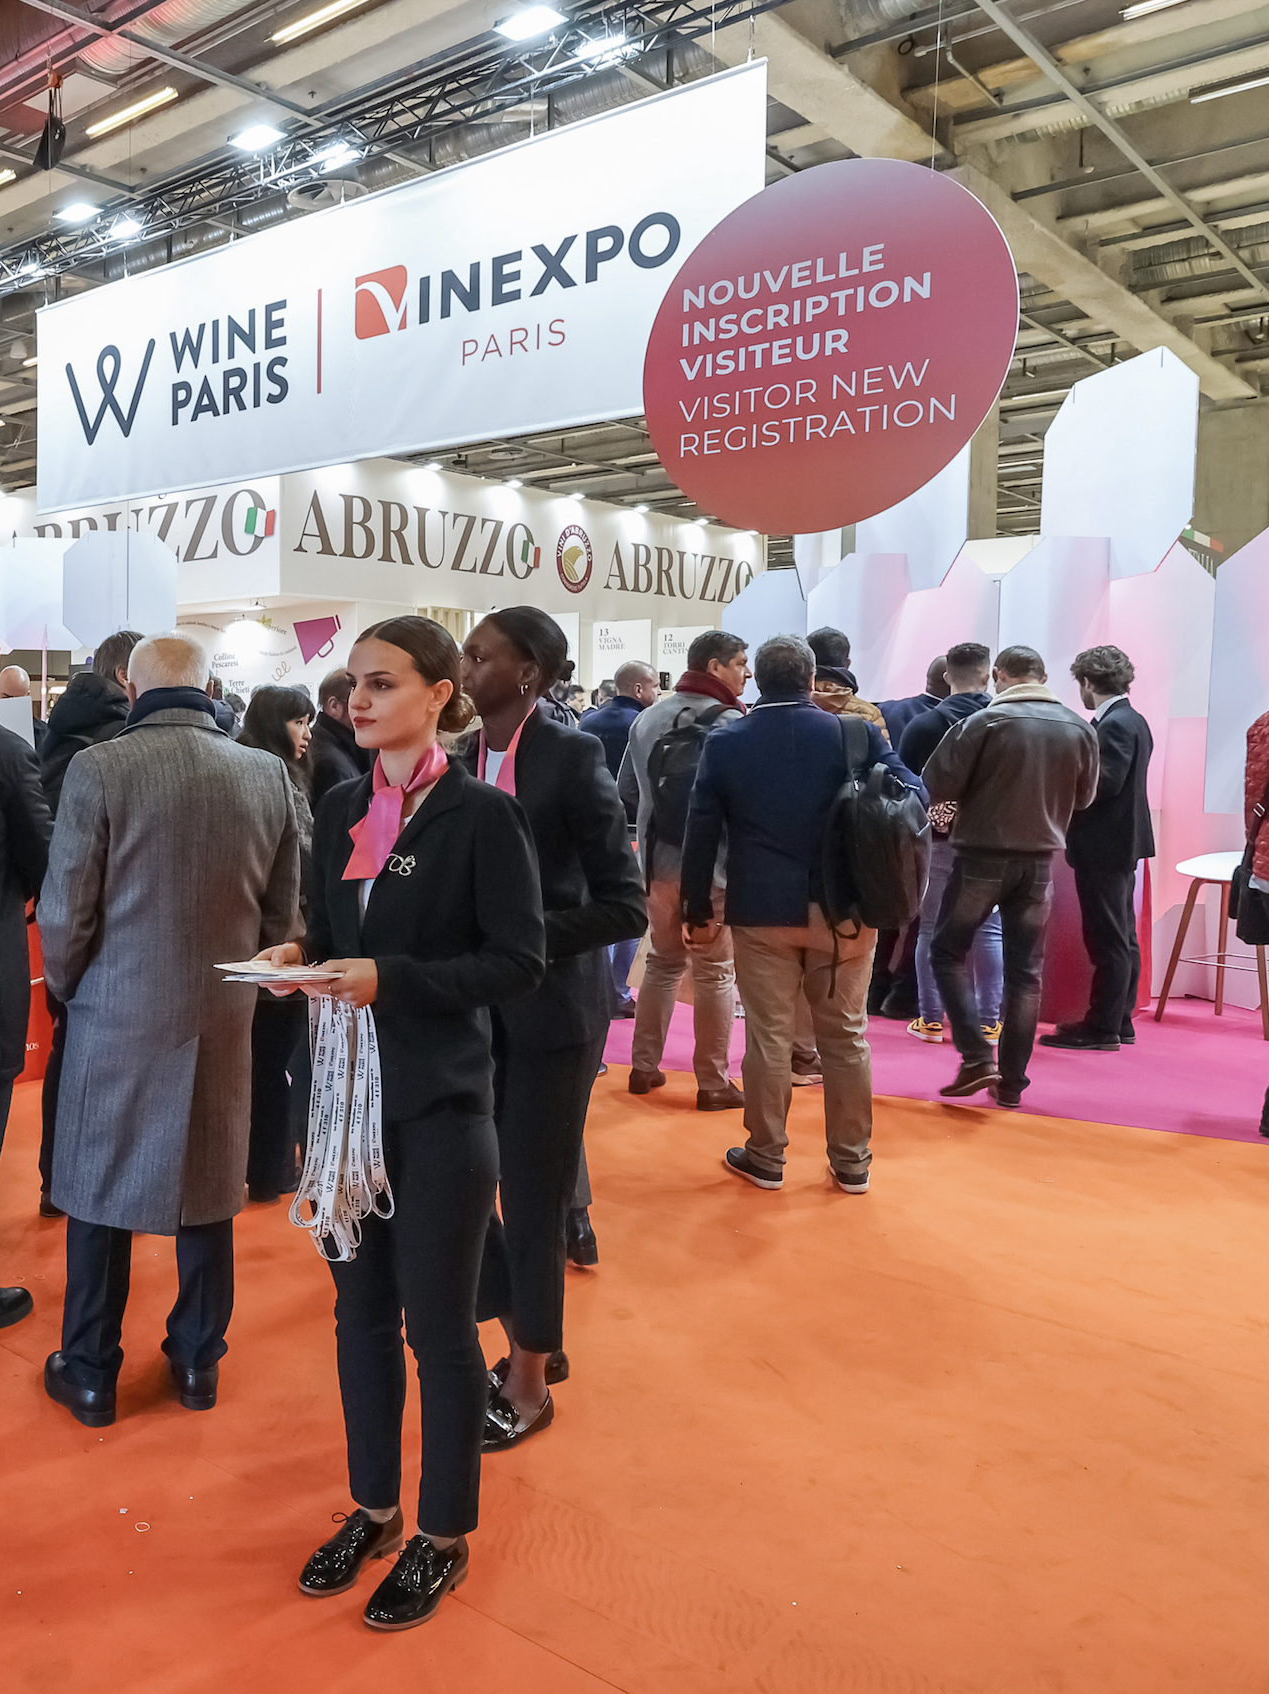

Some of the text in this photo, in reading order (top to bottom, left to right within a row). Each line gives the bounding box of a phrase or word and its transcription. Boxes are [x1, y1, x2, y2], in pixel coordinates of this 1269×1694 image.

[681, 271, 932, 348] INSCRIPTION
[682, 243, 886, 313] NOUVELLE
[169, 299, 287, 374] WINE
[462, 318, 566, 366] PARIS
[679, 328, 850, 382] VISITEUR
[171, 355, 289, 427] PARIS
[679, 358, 931, 423] VISITOR NEW
[679, 393, 957, 458] REGISTRATION
[293, 489, 536, 580] ABRUZZO
[556, 535, 566, 557] VINI
[212, 661, 239, 669] Pescaresi
